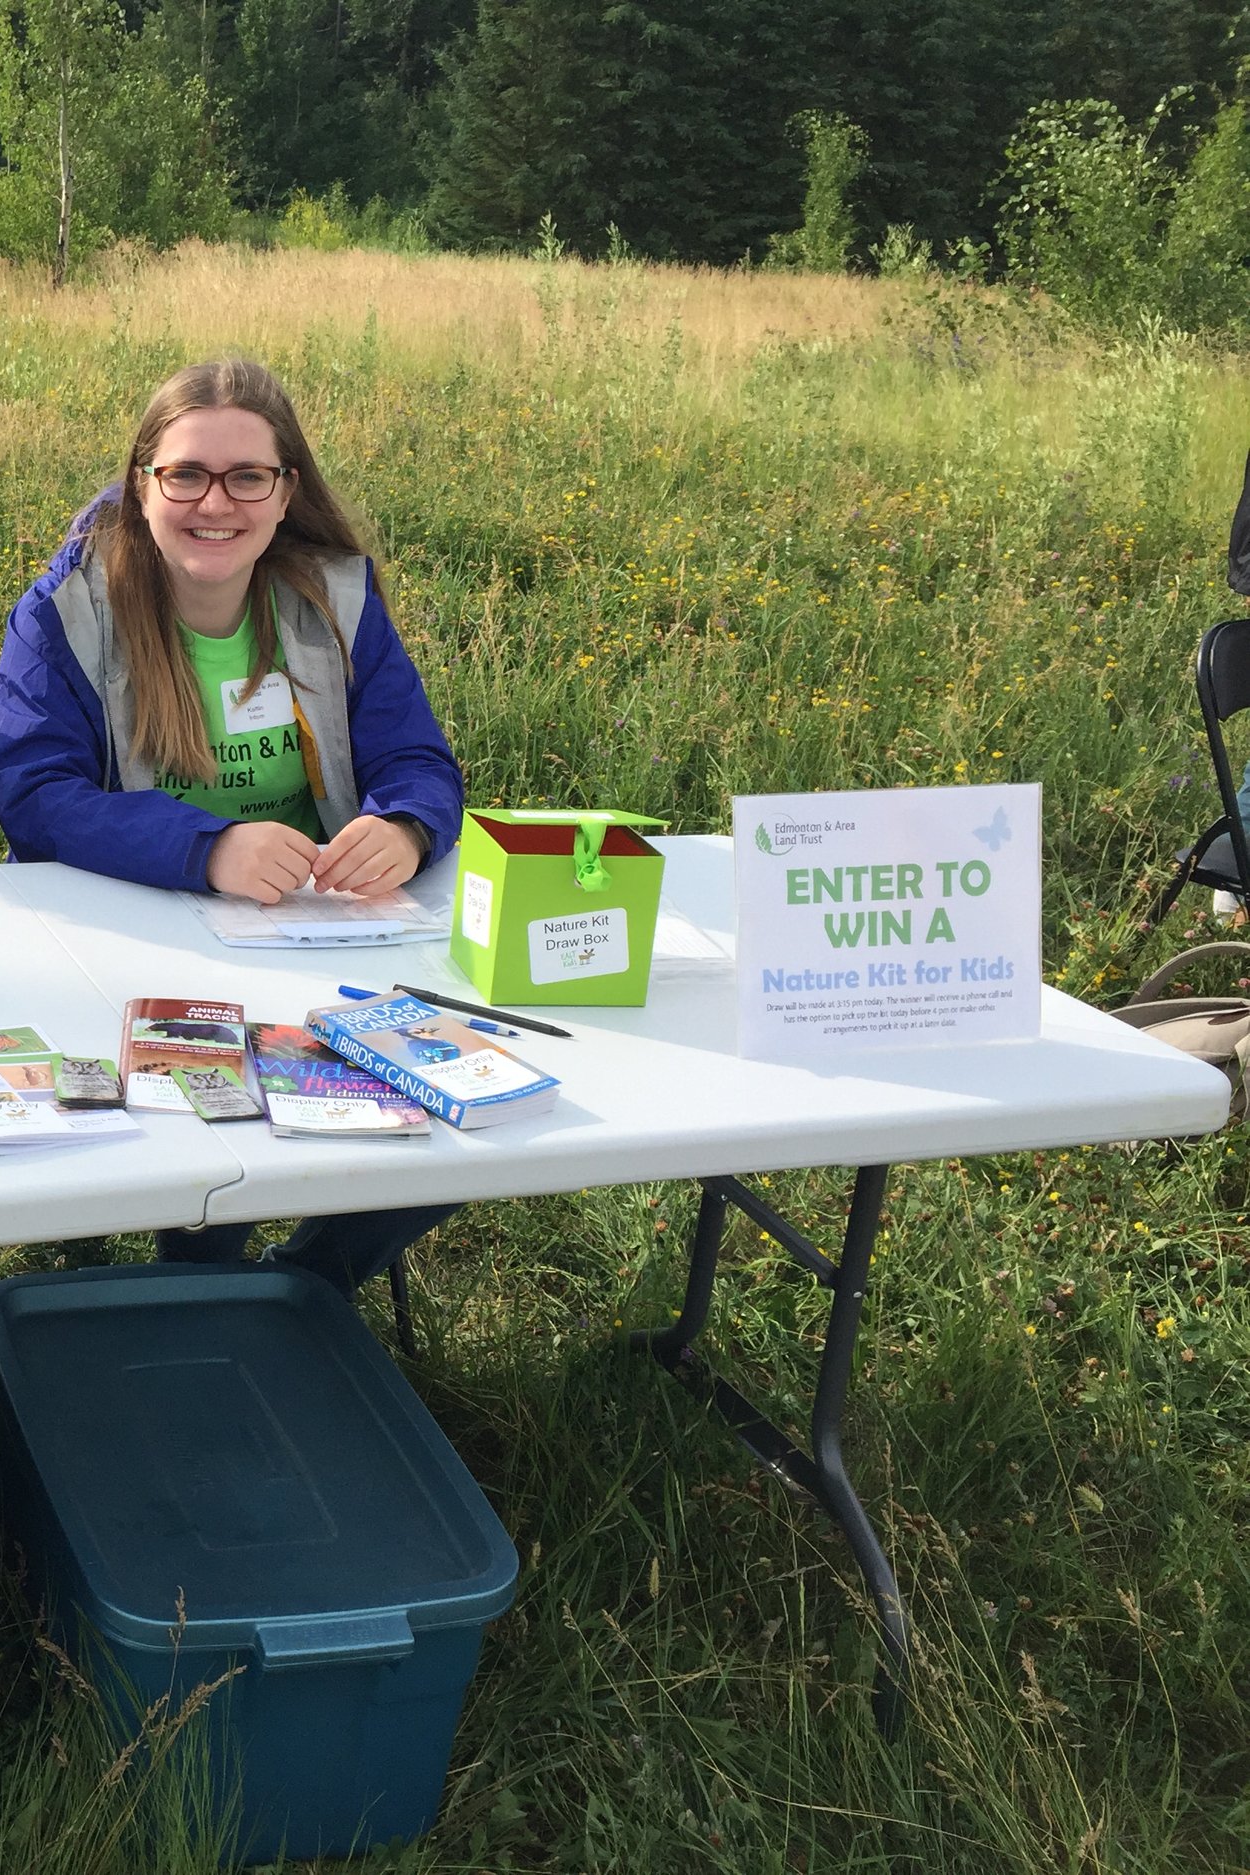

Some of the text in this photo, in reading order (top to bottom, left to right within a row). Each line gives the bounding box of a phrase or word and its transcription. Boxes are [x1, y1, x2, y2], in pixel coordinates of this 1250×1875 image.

[259, 736, 277, 758] &
[204, 767, 255, 790] ust
[774, 821, 856, 834] Edmonton & Area
[774, 834, 823, 845] Land Trust
[786, 859, 991, 905] ENTER TO
[544, 915, 609, 934] Nature Kit
[824, 907, 956, 949] WIN A
[546, 933, 609, 950] Draw Box
[762, 955, 1015, 993] Nature Kit for Kids
[188, 1007, 239, 1016] ANIMAL
[338, 1002, 402, 1024] BIRDS
[402, 1001, 418, 1011] of
[767, 1003, 784, 1011] Draw
[799, 1002, 807, 1010] be
[185, 1012, 239, 1022] TRACKS
[356, 1008, 434, 1032] CANADA
[256, 1058, 344, 1079] Wild
[465, 1053, 494, 1065] Only
[338, 1035, 375, 1069] BIRDS
[375, 1063, 386, 1073] of
[386, 1066, 444, 1114] CANADA
[7, 1100, 40, 1109] Only
[275, 1095, 367, 1109] Display Only
